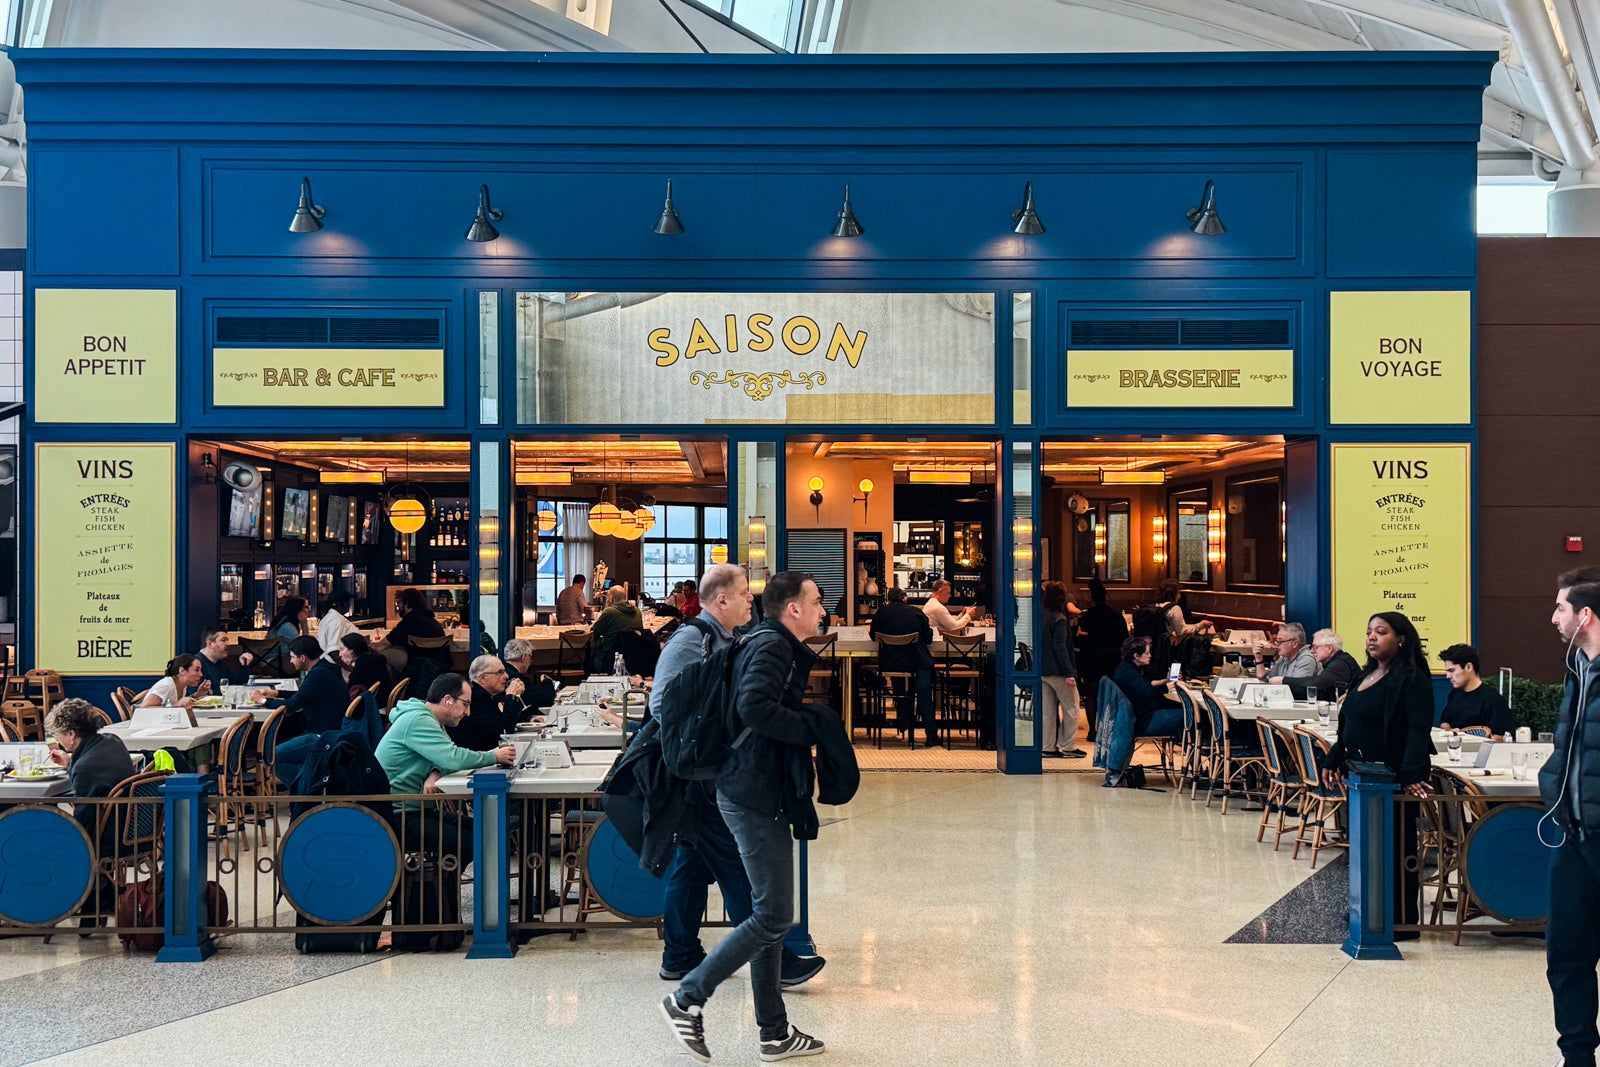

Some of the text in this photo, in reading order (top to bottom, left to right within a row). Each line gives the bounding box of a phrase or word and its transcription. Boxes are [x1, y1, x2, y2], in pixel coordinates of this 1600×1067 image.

[83, 336, 126, 352] BON
[647, 313, 868, 369] SAISON
[1379, 338, 1422, 354] BON
[64, 359, 146, 375] APPETIT
[1360, 361, 1442, 377] VOYAGE
[263, 368, 396, 387] BAR & CAFE
[1119, 369, 1241, 388] BRASSERIE
[77, 460, 133, 479] VINS
[1372, 460, 1428, 479] VINS
[80, 492, 131, 508] ENTRÉES
[1375, 492, 1426, 508] ENTRÉES
[1381, 523, 1421, 531] CHICKEN
[77, 542, 134, 557] ASSIETTE
[1373, 542, 1429, 556] ASSIETTE
[100, 556, 110, 564] de
[1396, 555, 1406, 563] de
[1373, 562, 1429, 577] FROMAGES
[86, 592, 121, 600] Plateaux
[1383, 590, 1417, 599] Plateaux
[98, 604, 108, 612] de
[1395, 602, 1404, 610] de
[79, 615, 101, 624] fruits
[103, 615, 113, 624] de
[77, 635, 133, 658] BIÈRE
